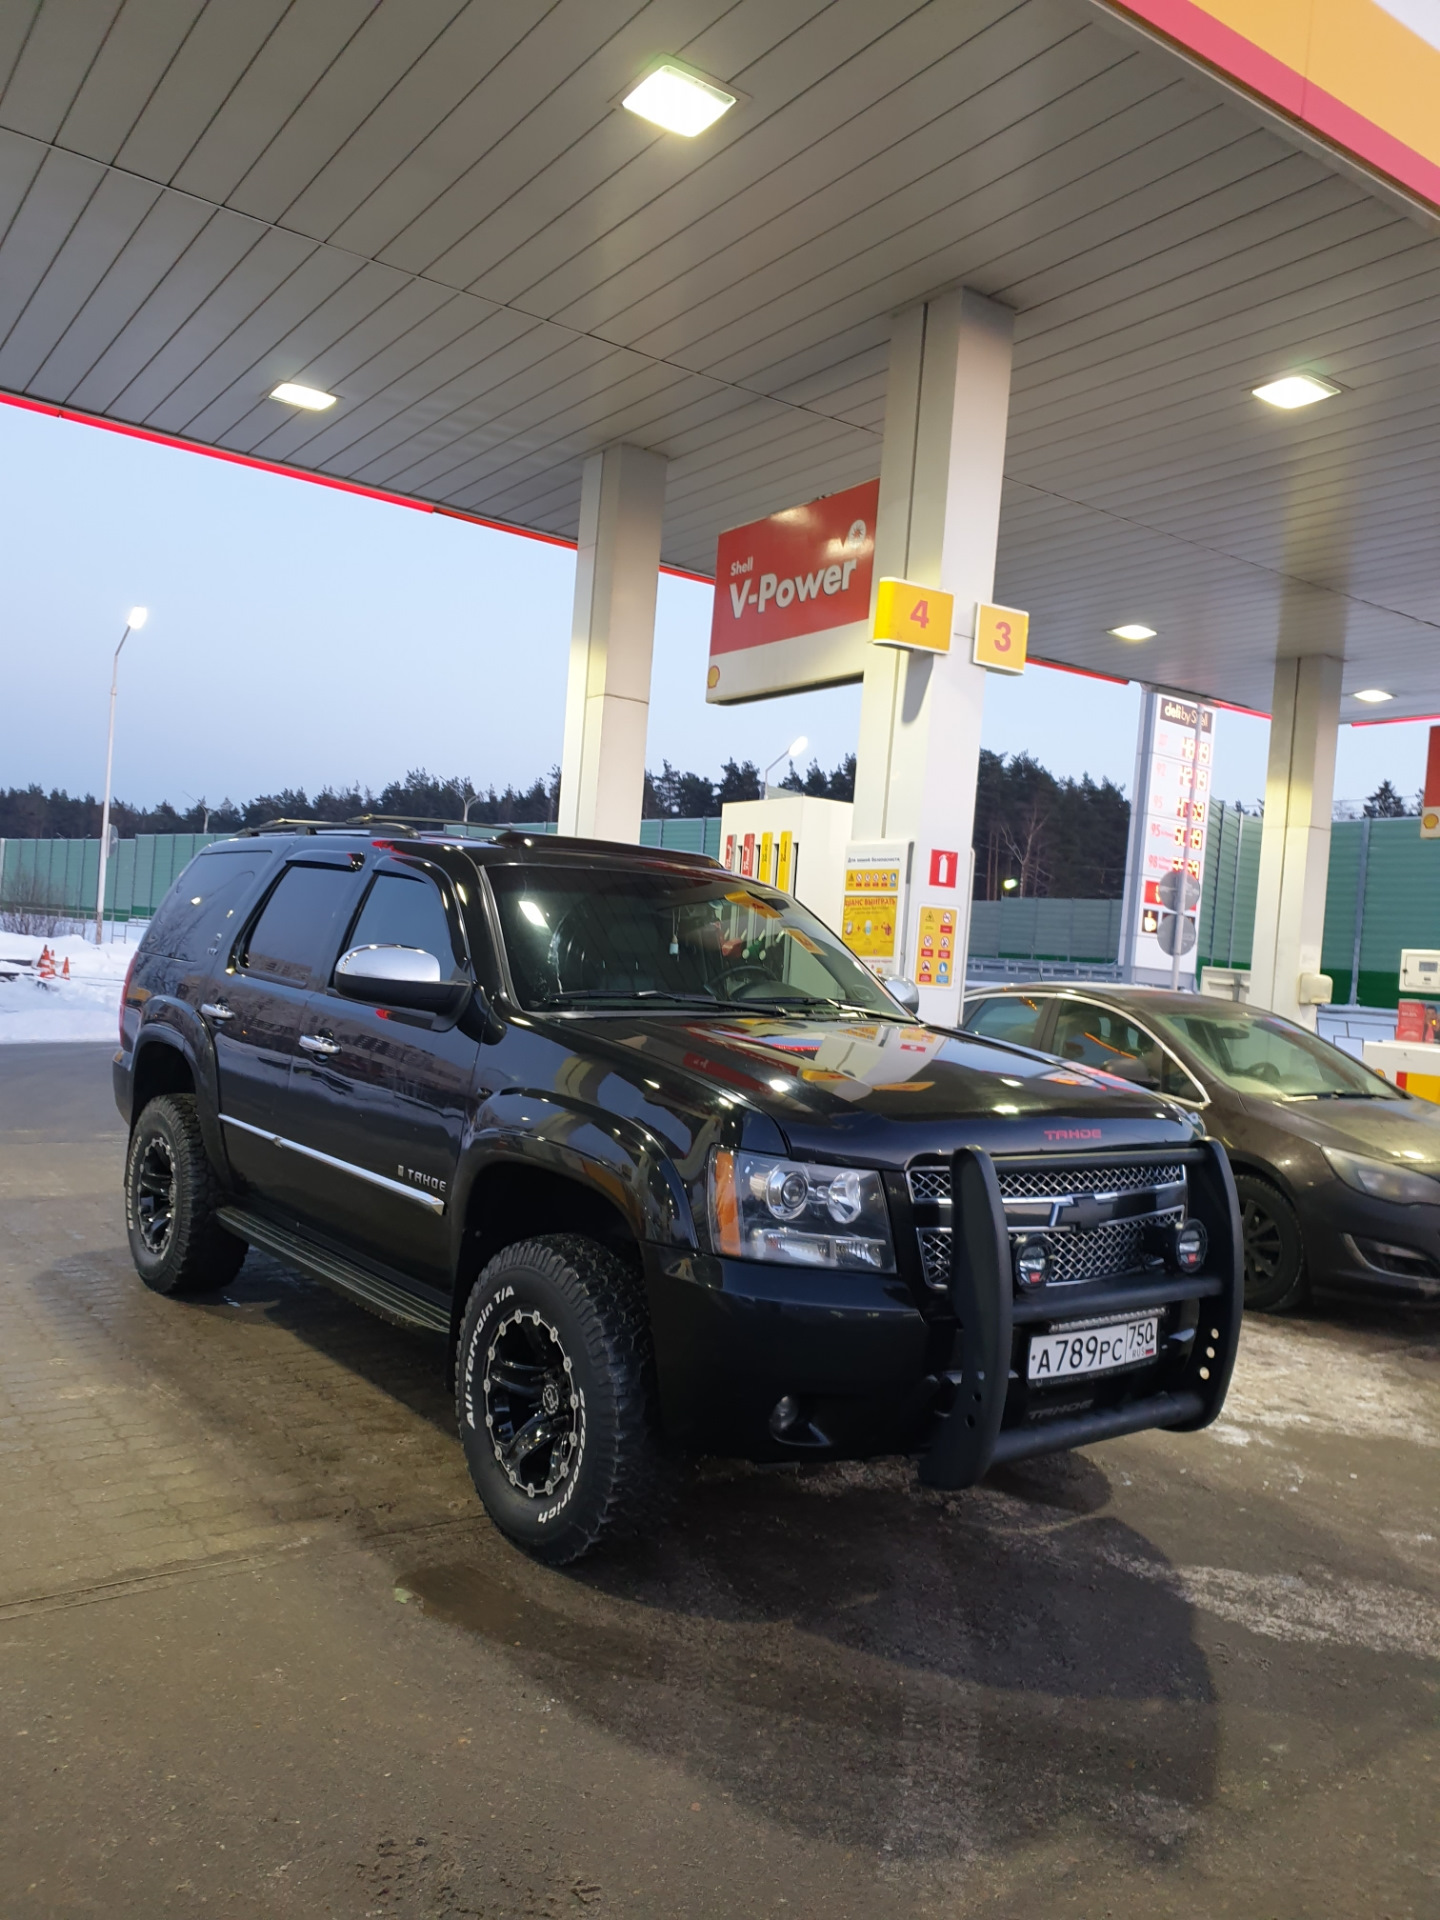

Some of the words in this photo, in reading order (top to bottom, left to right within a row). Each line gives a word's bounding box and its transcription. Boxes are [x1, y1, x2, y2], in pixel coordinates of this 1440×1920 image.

[730, 556, 754, 577] Shell
[729, 558, 858, 619] V-Power
[910, 599, 930, 629] 4
[994, 621, 1012, 653] 3
[1043, 1128, 1102, 1141] TAHOE
[407, 1168, 447, 1193] TAHOE
[1128, 1321, 1154, 1350] 750
[464, 1302, 494, 1430] All-Terrain
[493, 1285, 515, 1304] T/A
[1131, 1347, 1146, 1359] RUS
